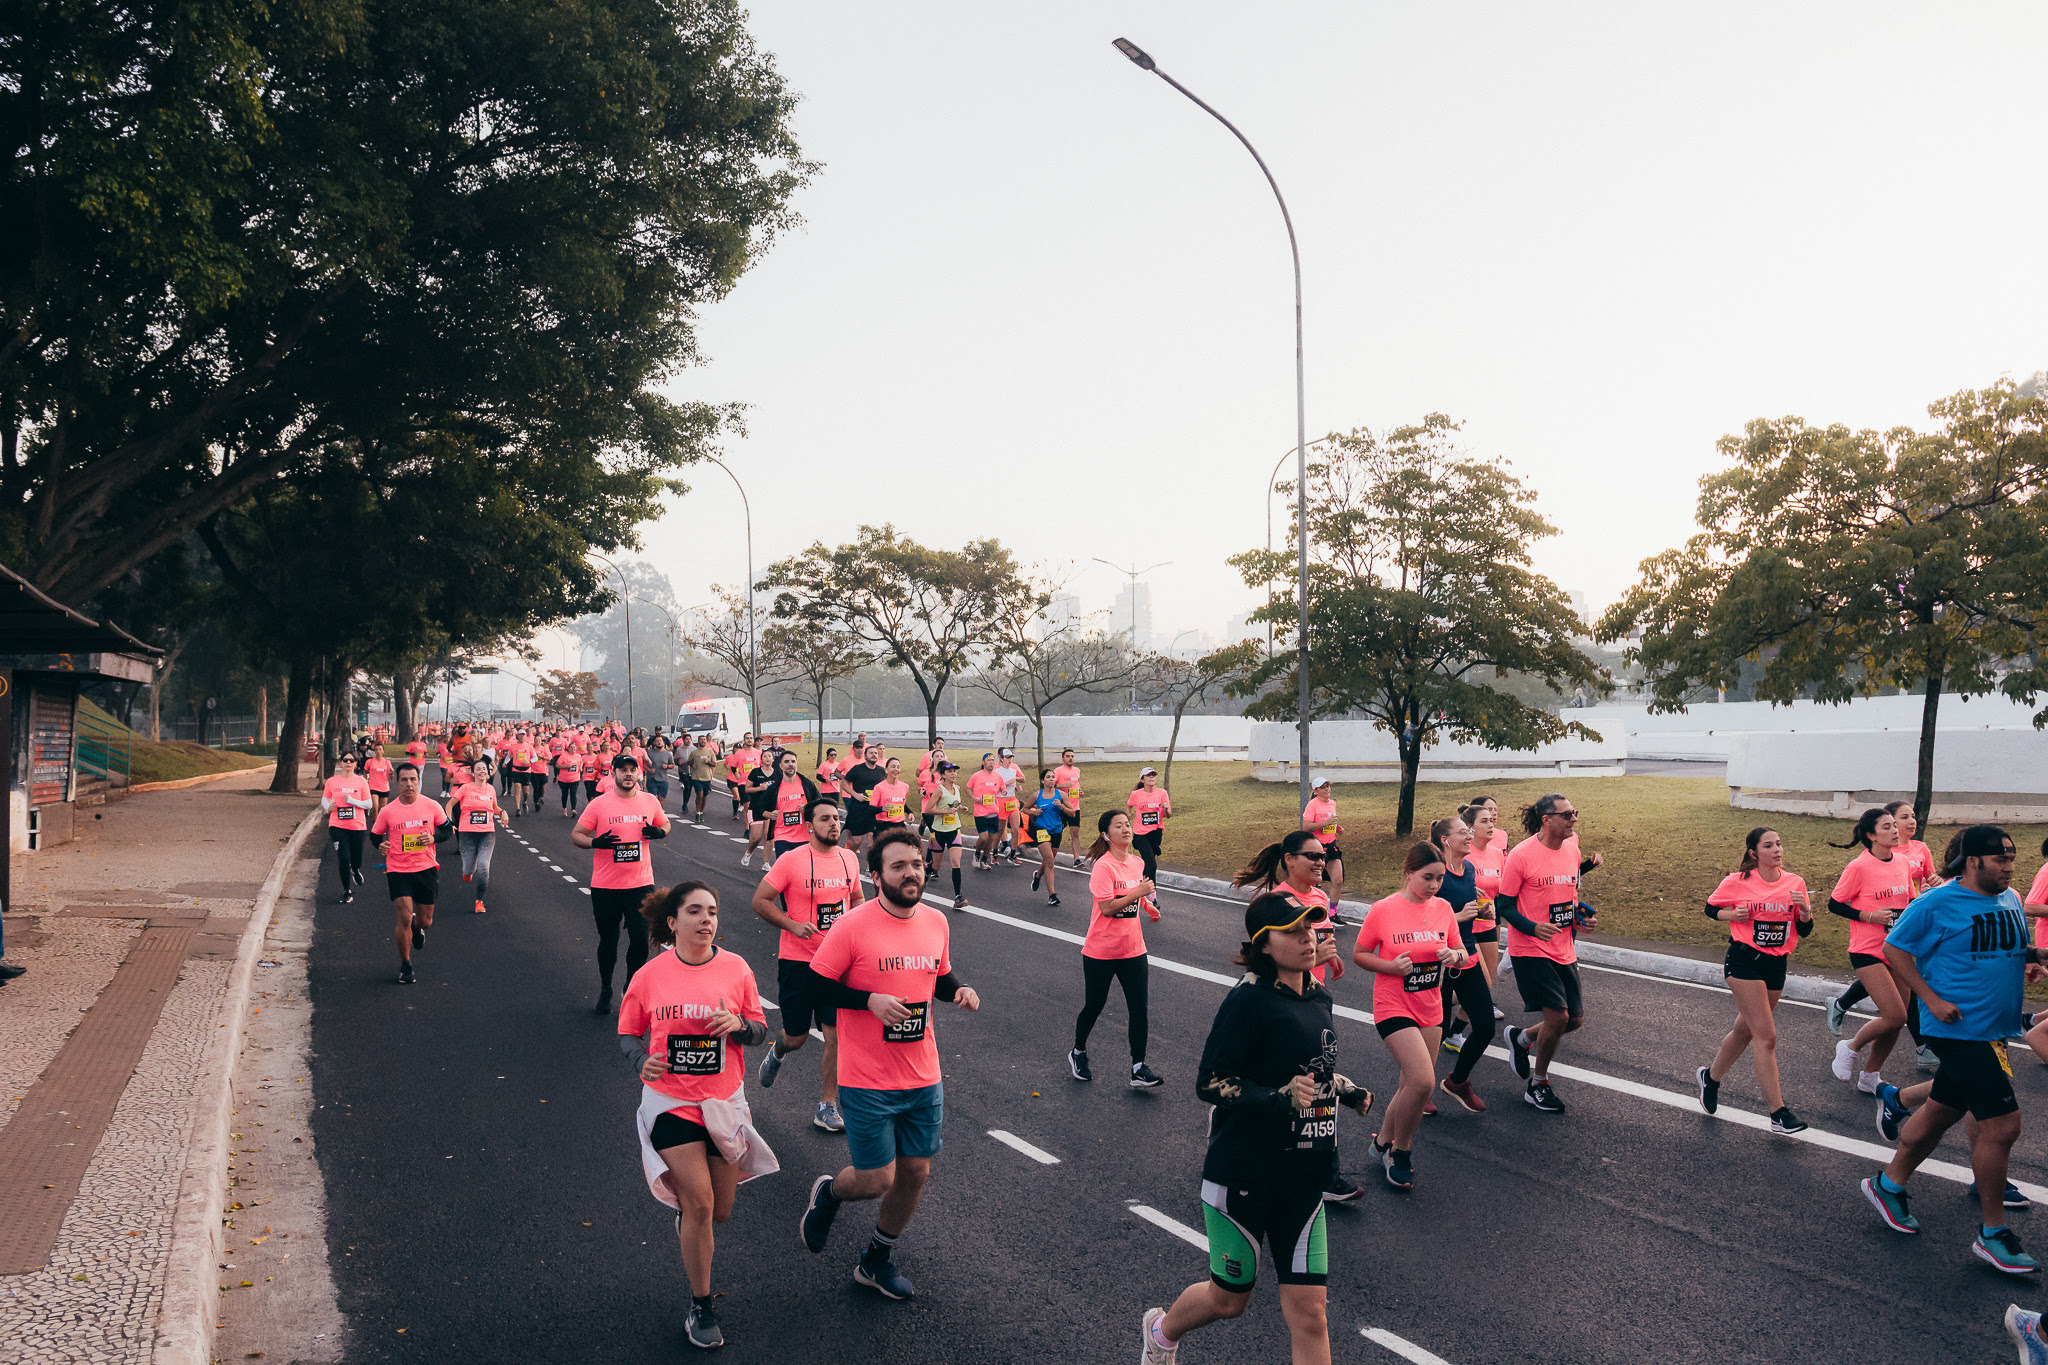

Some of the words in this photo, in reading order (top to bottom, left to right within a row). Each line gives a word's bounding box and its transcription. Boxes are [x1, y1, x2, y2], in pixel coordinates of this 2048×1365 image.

[617, 850, 639, 858] 5299
[1555, 911, 1573, 922] 5148
[1393, 930, 1439, 944] LIVE!RUN
[1757, 931, 1783, 941] 5702
[879, 956, 934, 972] LIVE!RUN
[1408, 972, 1438, 985] 4487
[892, 1018, 922, 1032] 5571
[675, 1051, 717, 1065] 5572
[1300, 1105, 1331, 1119] LIVE!RUN
[1300, 1119, 1335, 1138] 4159
